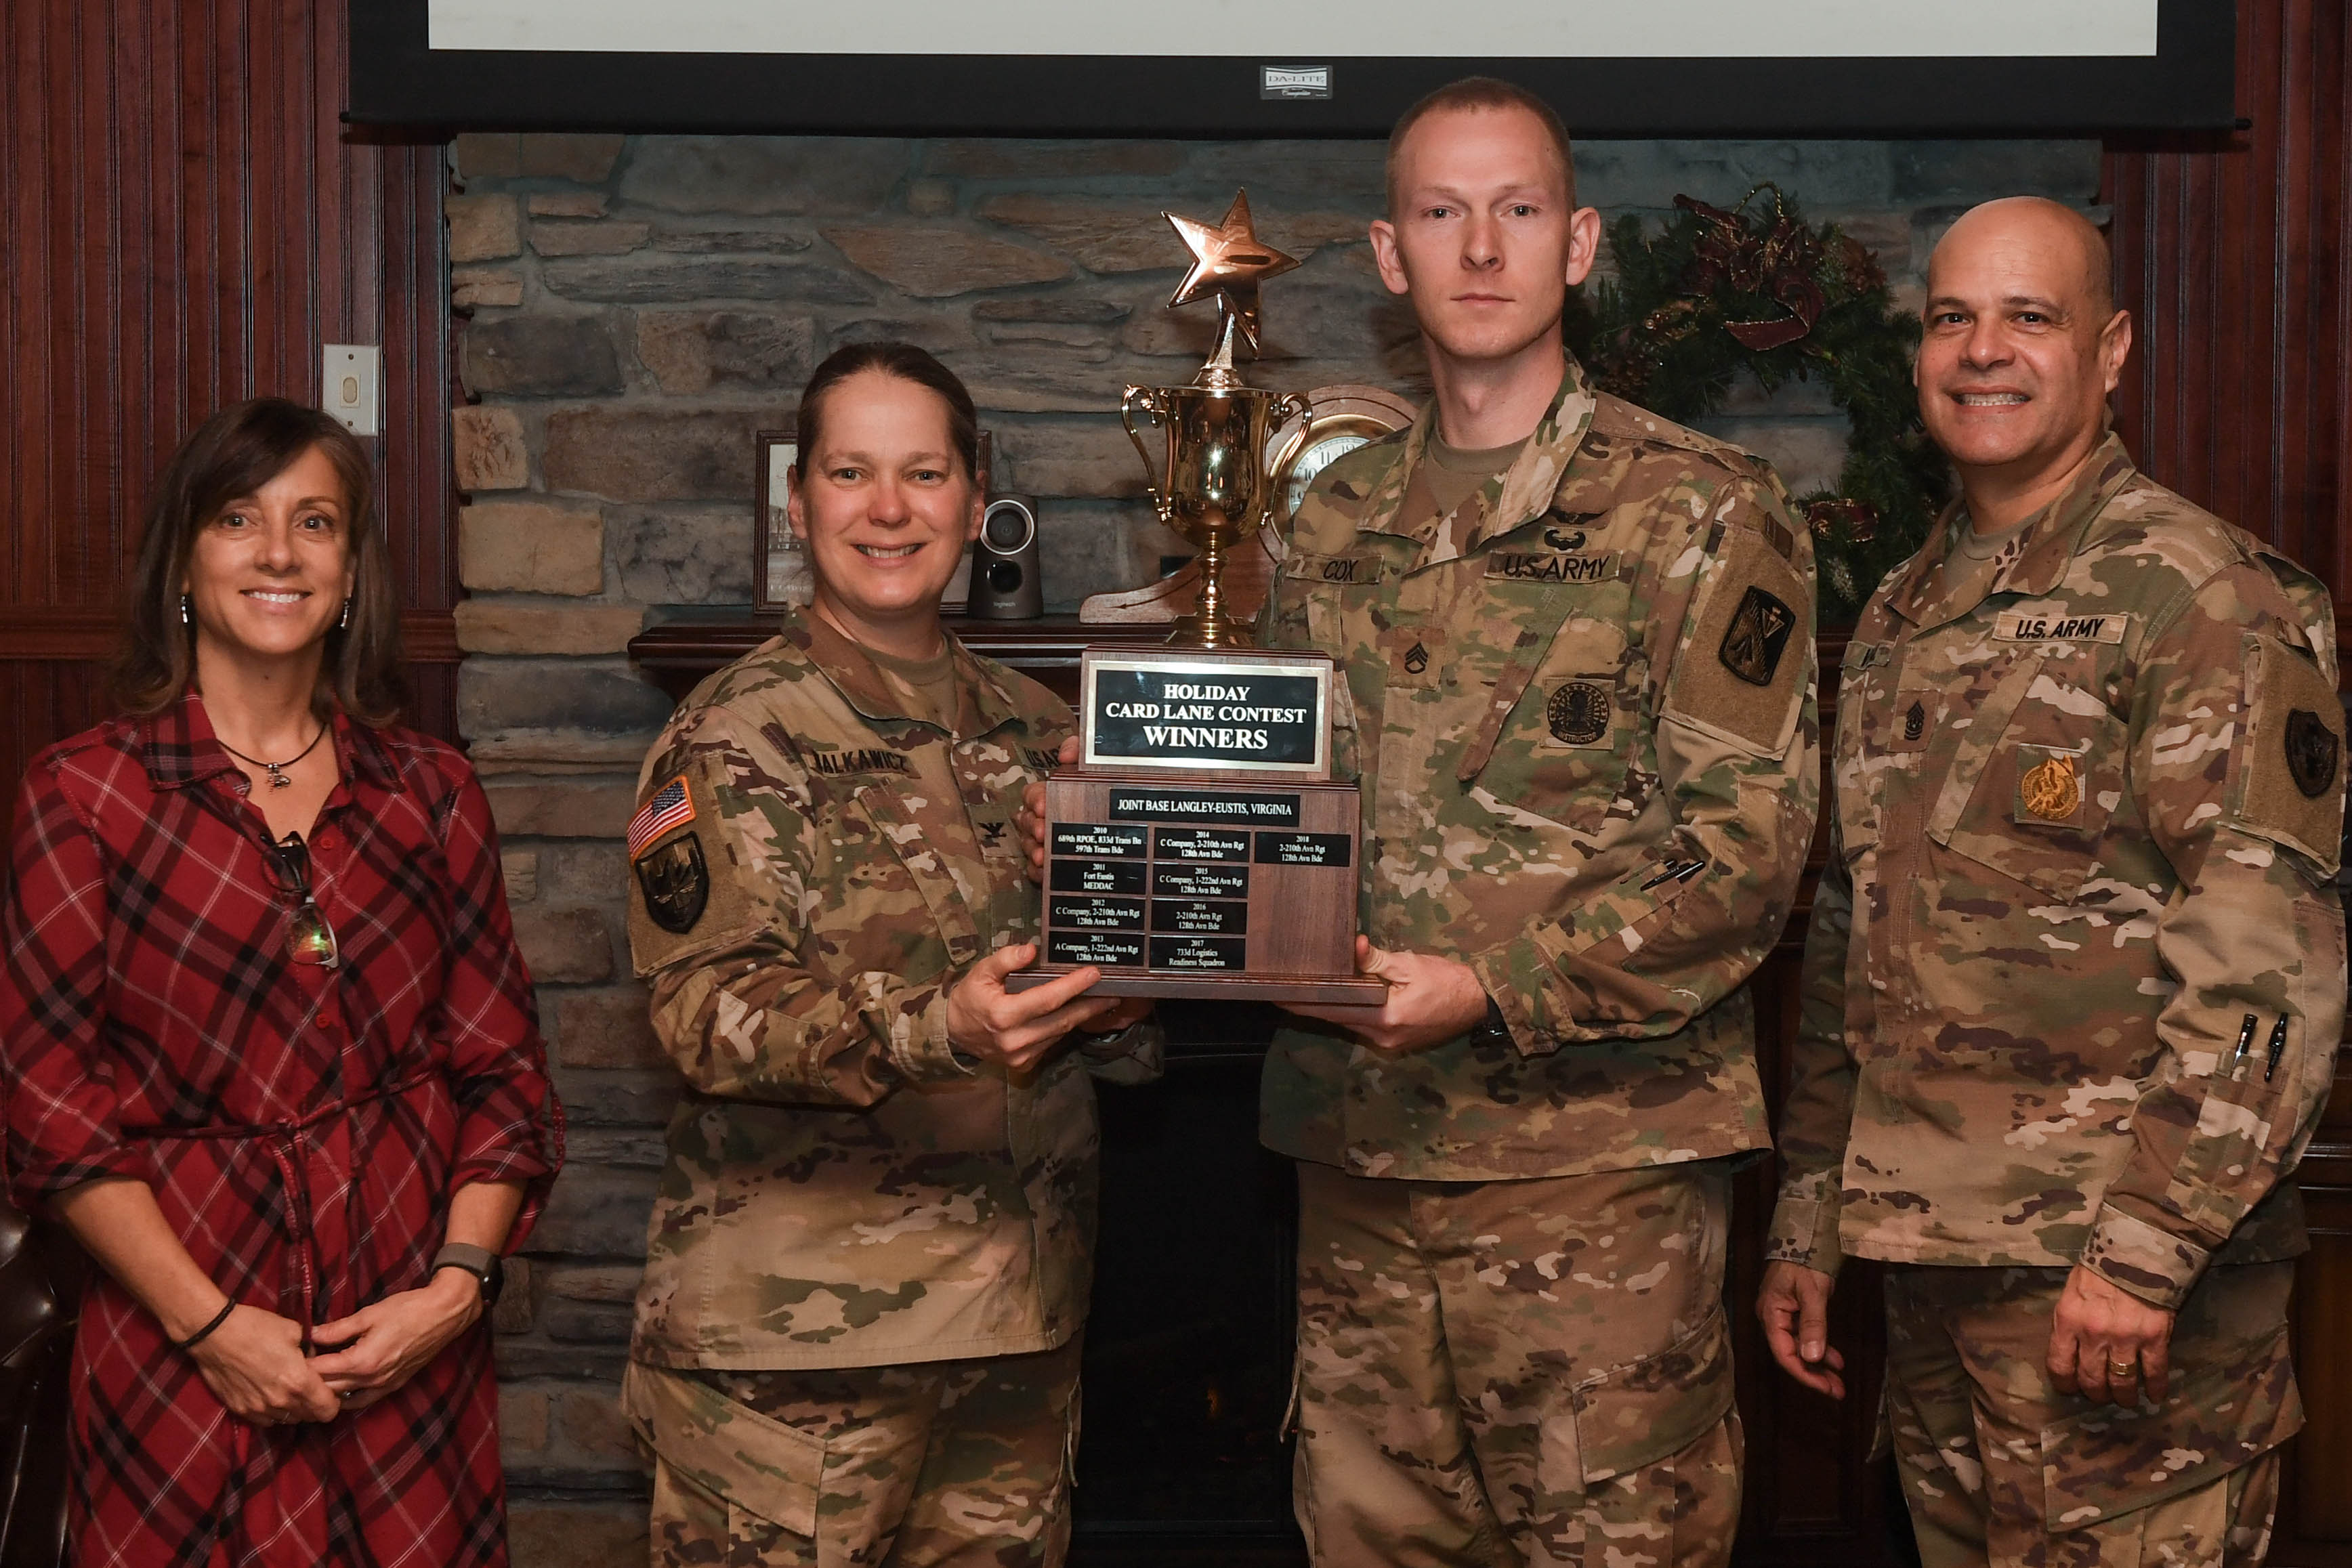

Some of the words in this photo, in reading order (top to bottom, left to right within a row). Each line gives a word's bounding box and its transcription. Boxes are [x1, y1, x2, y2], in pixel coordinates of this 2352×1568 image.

[1321, 451, 1330, 465] 11
[1323, 560, 1358, 581] COX
[1542, 555, 1610, 579] ARMY
[2015, 620, 2046, 638] U.S.
[2050, 618, 2105, 638] ARMY
[1164, 684, 1251, 700] HOLIDAY
[1106, 702, 1160, 719] CARD
[1164, 705, 1215, 721] LANE
[1219, 706, 1307, 723] CONTEST
[1143, 726, 1268, 749] WINNERS
[1118, 799, 1144, 811] JOINT
[1146, 801, 1169, 811] BASE
[1171, 801, 1249, 815] LANGLEY-EUSTIS,
[1251, 803, 1292, 815] VIRGINIA
[1133, 836, 1141, 845] Bn
[1167, 839, 1196, 849] Company,
[1234, 841, 1244, 851] Rgt
[1315, 845, 1326, 854] Rgt
[1166, 876, 1194, 885] Company,
[1196, 876, 1219, 885] 1-222nd
[1232, 878, 1242, 887] Rgt
[1062, 908, 1091, 916] Company,
[1129, 909, 1140, 918] Rgt
[1212, 913, 1222, 922] Rgt
[1062, 944, 1090, 952] Company,
[1091, 944, 1114, 952] 1-222nd
[1128, 946, 1138, 954] Rgt
[1192, 949, 1218, 958] Logistics
[1198, 958, 1225, 968] Squadron
